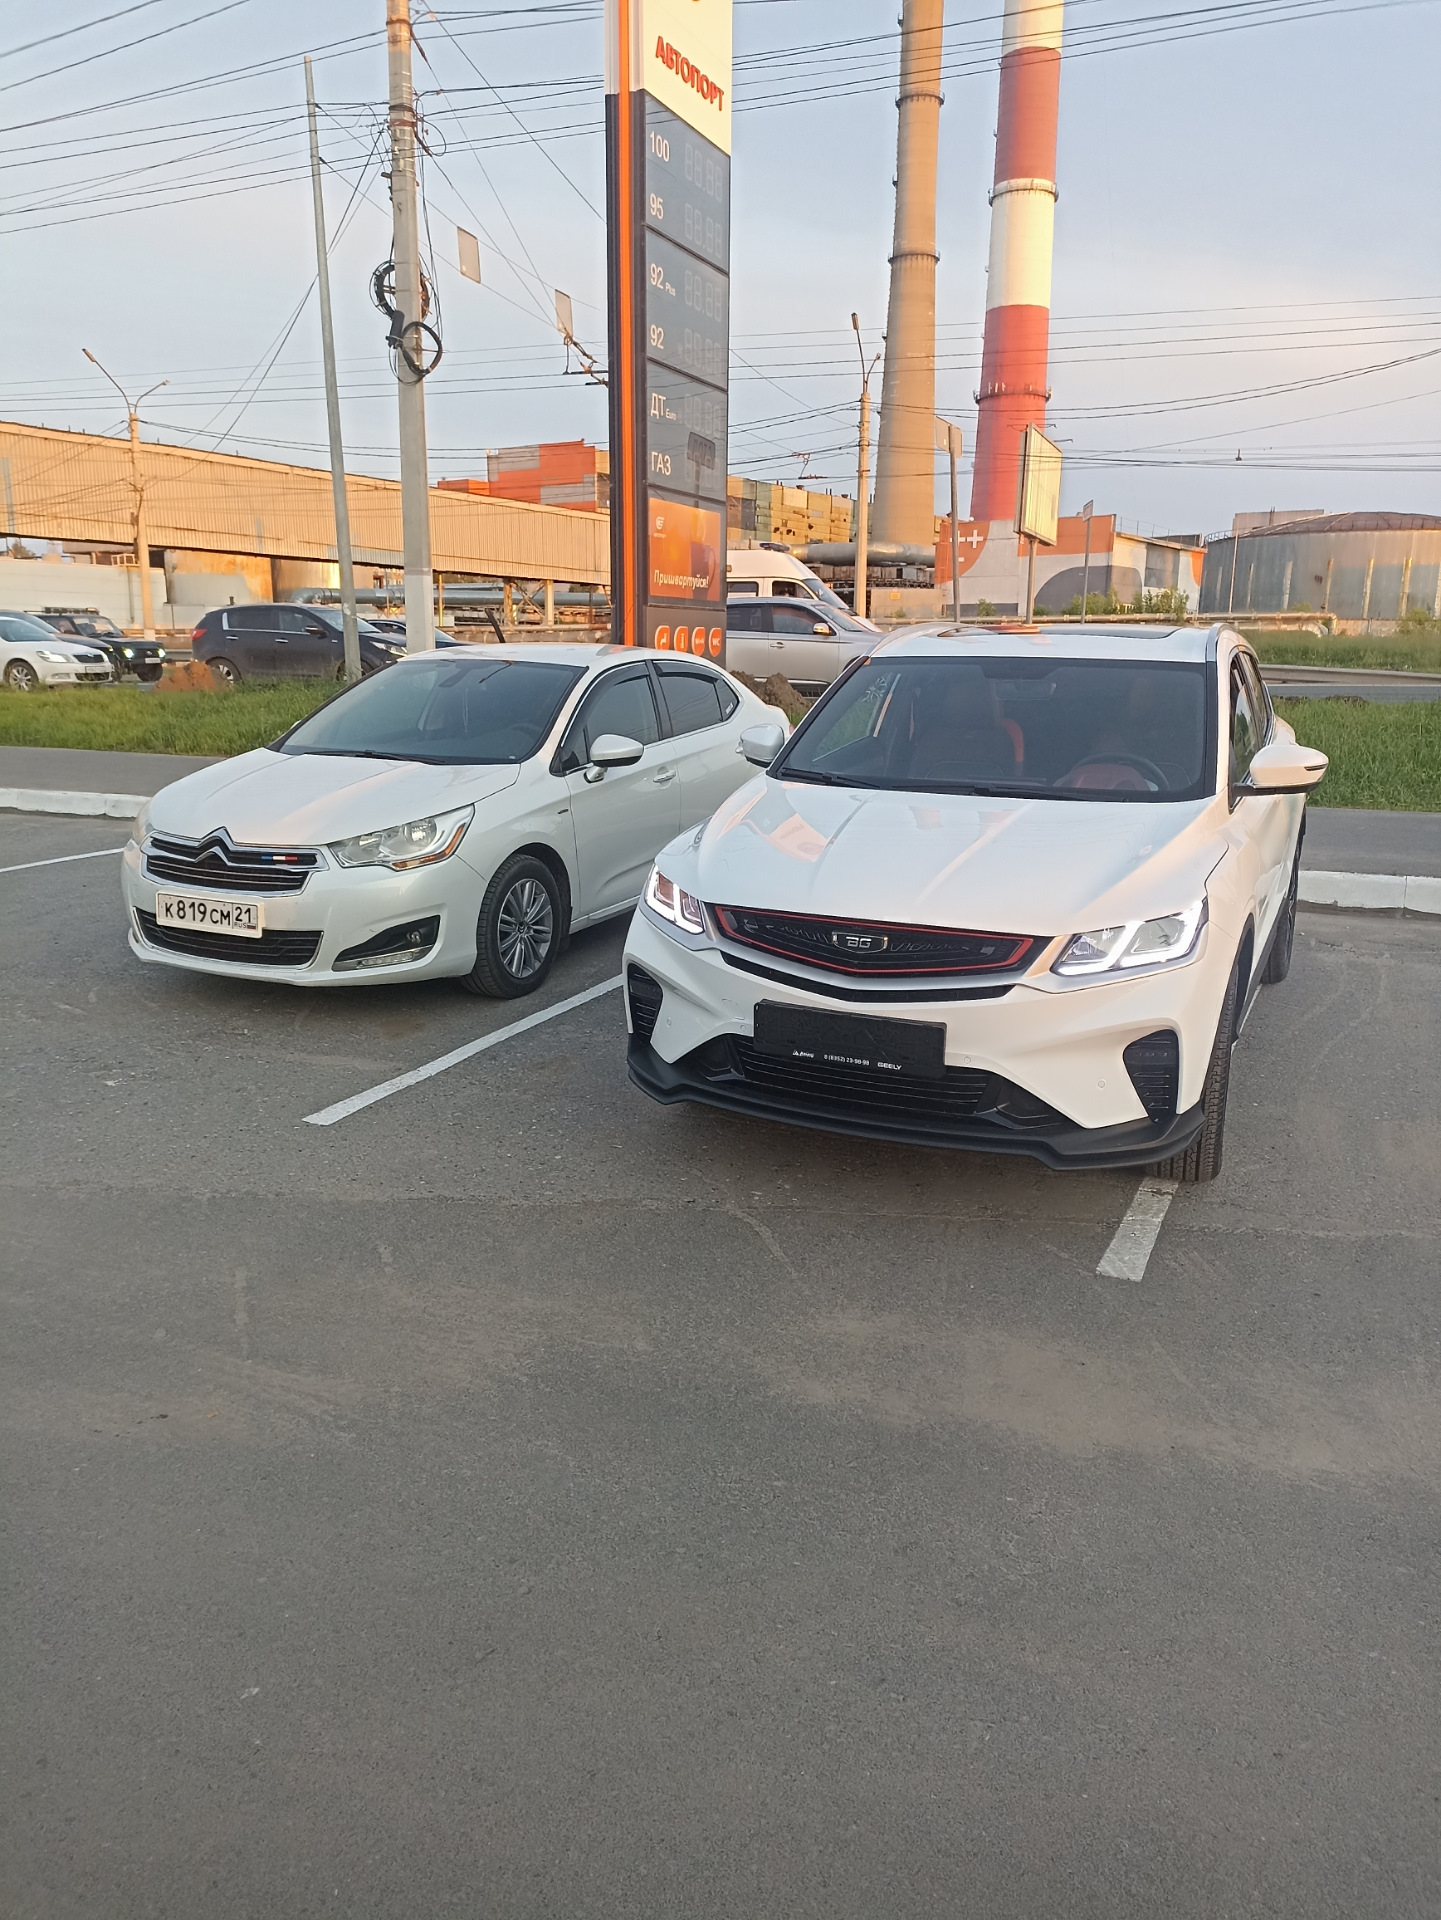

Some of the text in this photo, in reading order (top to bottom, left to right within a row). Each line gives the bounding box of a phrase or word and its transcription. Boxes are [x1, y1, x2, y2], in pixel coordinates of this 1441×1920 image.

[655, 36, 724, 111] АВТОПОРТ
[650, 131, 670, 162] 100
[650, 193, 664, 220] 95
[650, 263, 676, 297] 92 Plus
[650, 324, 665, 350] 92
[651, 393, 666, 419] ДТ
[651, 451, 671, 476] ГАЗ
[654, 569, 709, 589] Пришвартуйся!
[712, 637, 720, 647] WC
[235, 906, 251, 923] 21
[877, 1061, 902, 1070] GEELY
